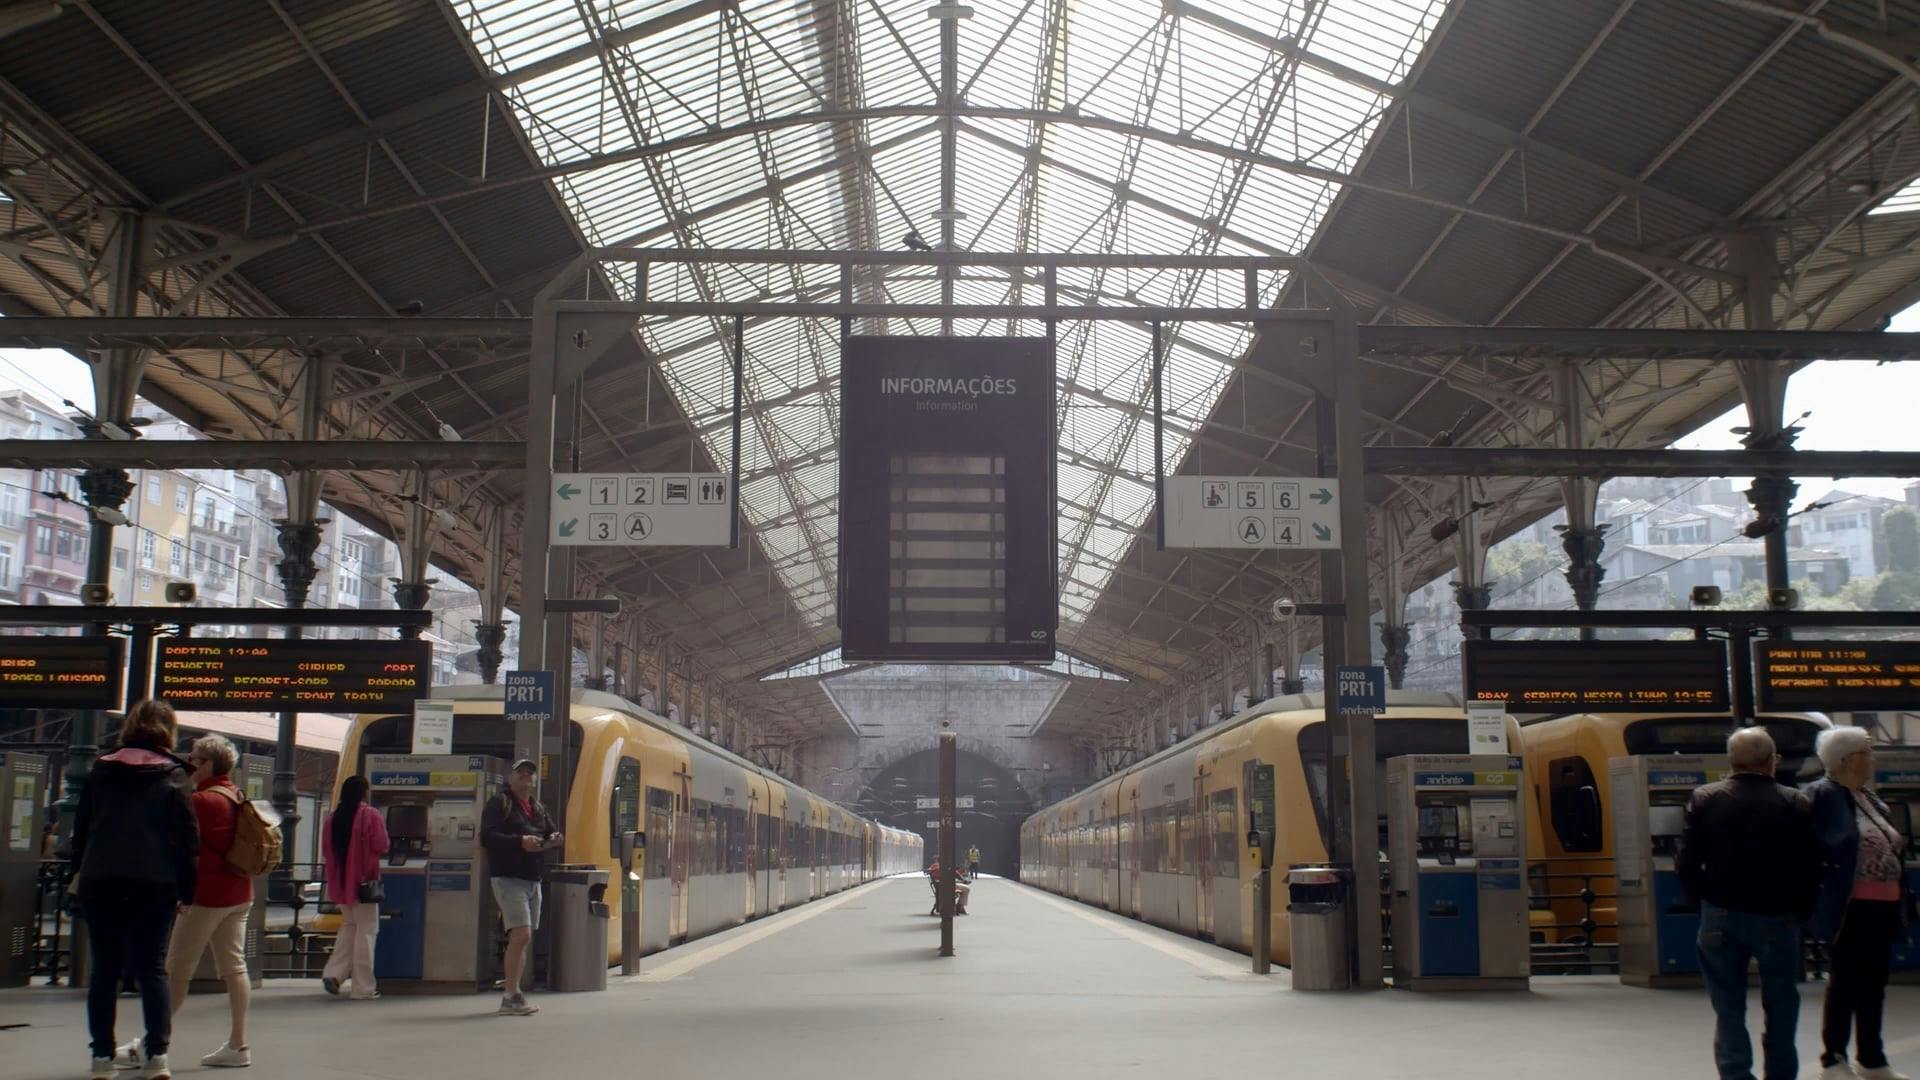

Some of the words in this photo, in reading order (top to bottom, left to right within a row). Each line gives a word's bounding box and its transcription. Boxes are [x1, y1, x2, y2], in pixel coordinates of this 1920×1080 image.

[881, 375, 1017, 398] INFORMAÇÕES
[916, 400, 978, 411] Information
[600, 487, 608, 503] 1
[634, 487, 646, 503] 2
[1246, 491, 1257, 507] 5
[1280, 492, 1292, 508] 6
[598, 522, 609, 539] 3
[630, 518, 646, 535] A
[1244, 522, 1260, 539] A
[1280, 526, 1292, 543] 4
[508, 676, 536, 685] zona
[1339, 671, 1366, 680] zona
[507, 686, 544, 702] PRT1
[1339, 680, 1374, 697] PRT1
